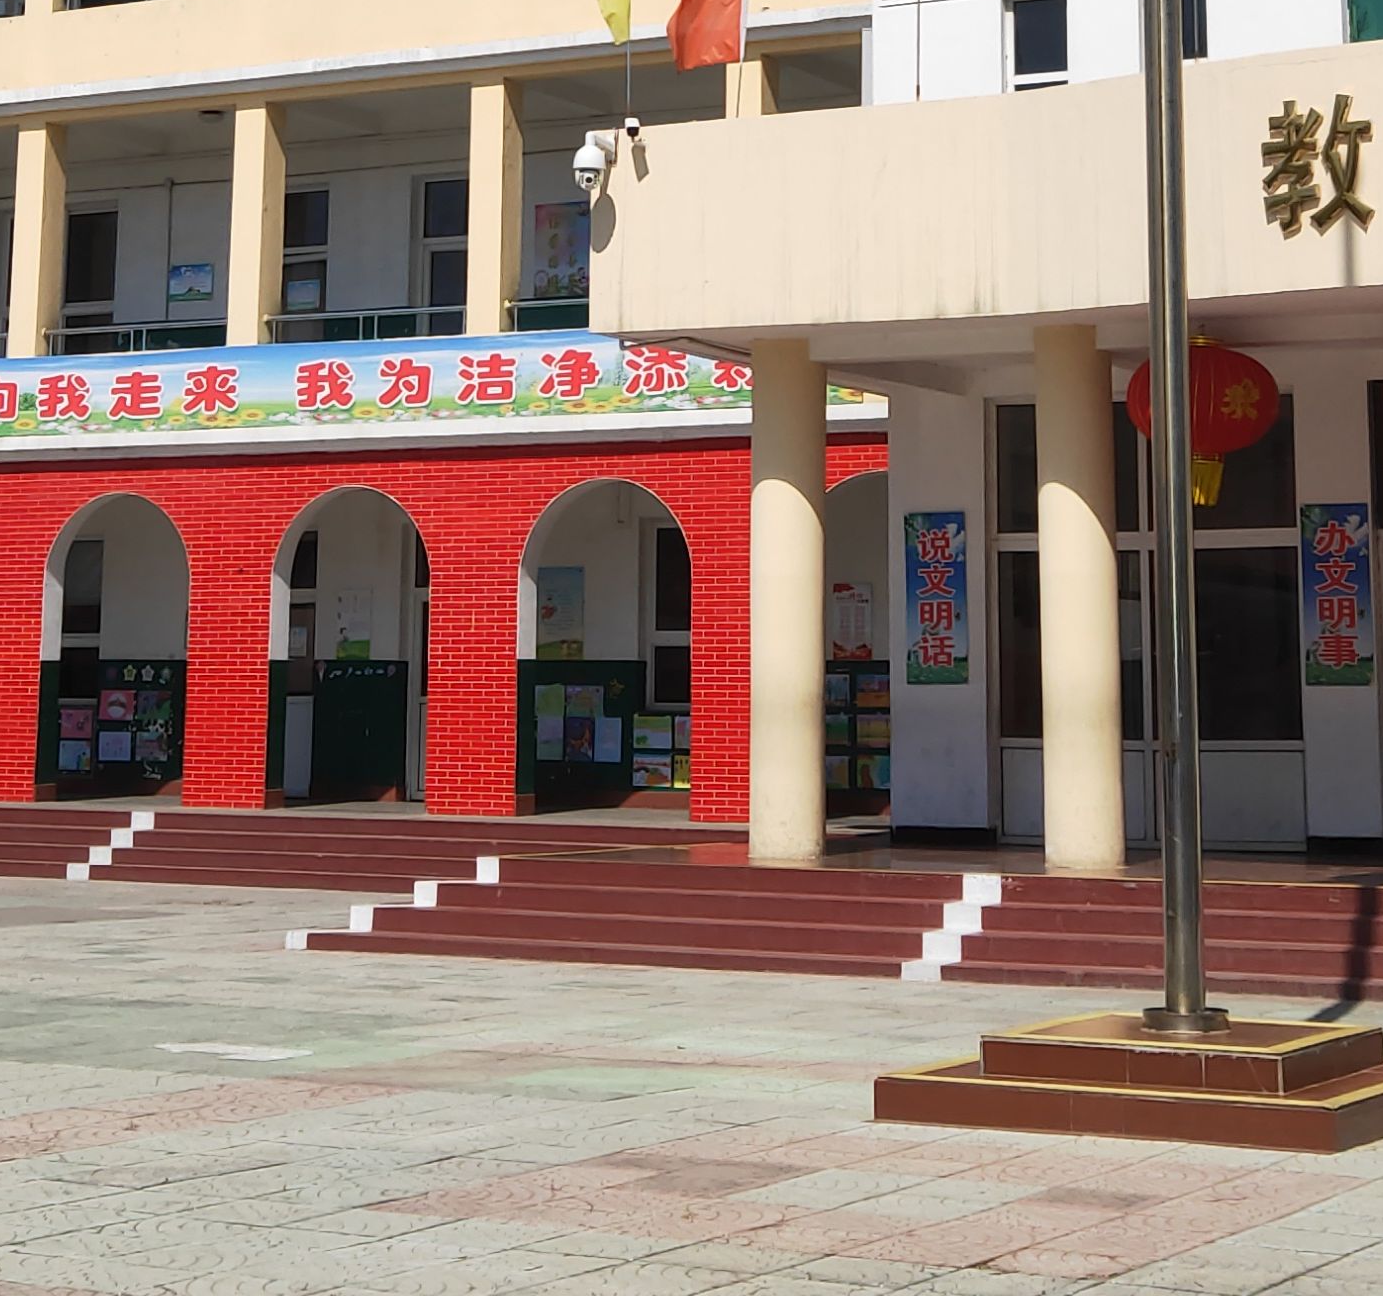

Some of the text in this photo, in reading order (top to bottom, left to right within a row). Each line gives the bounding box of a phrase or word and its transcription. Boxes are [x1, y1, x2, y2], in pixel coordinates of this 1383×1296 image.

[916, 529, 956, 669] 说文明话
[1313, 520, 1360, 669] 办文明事
